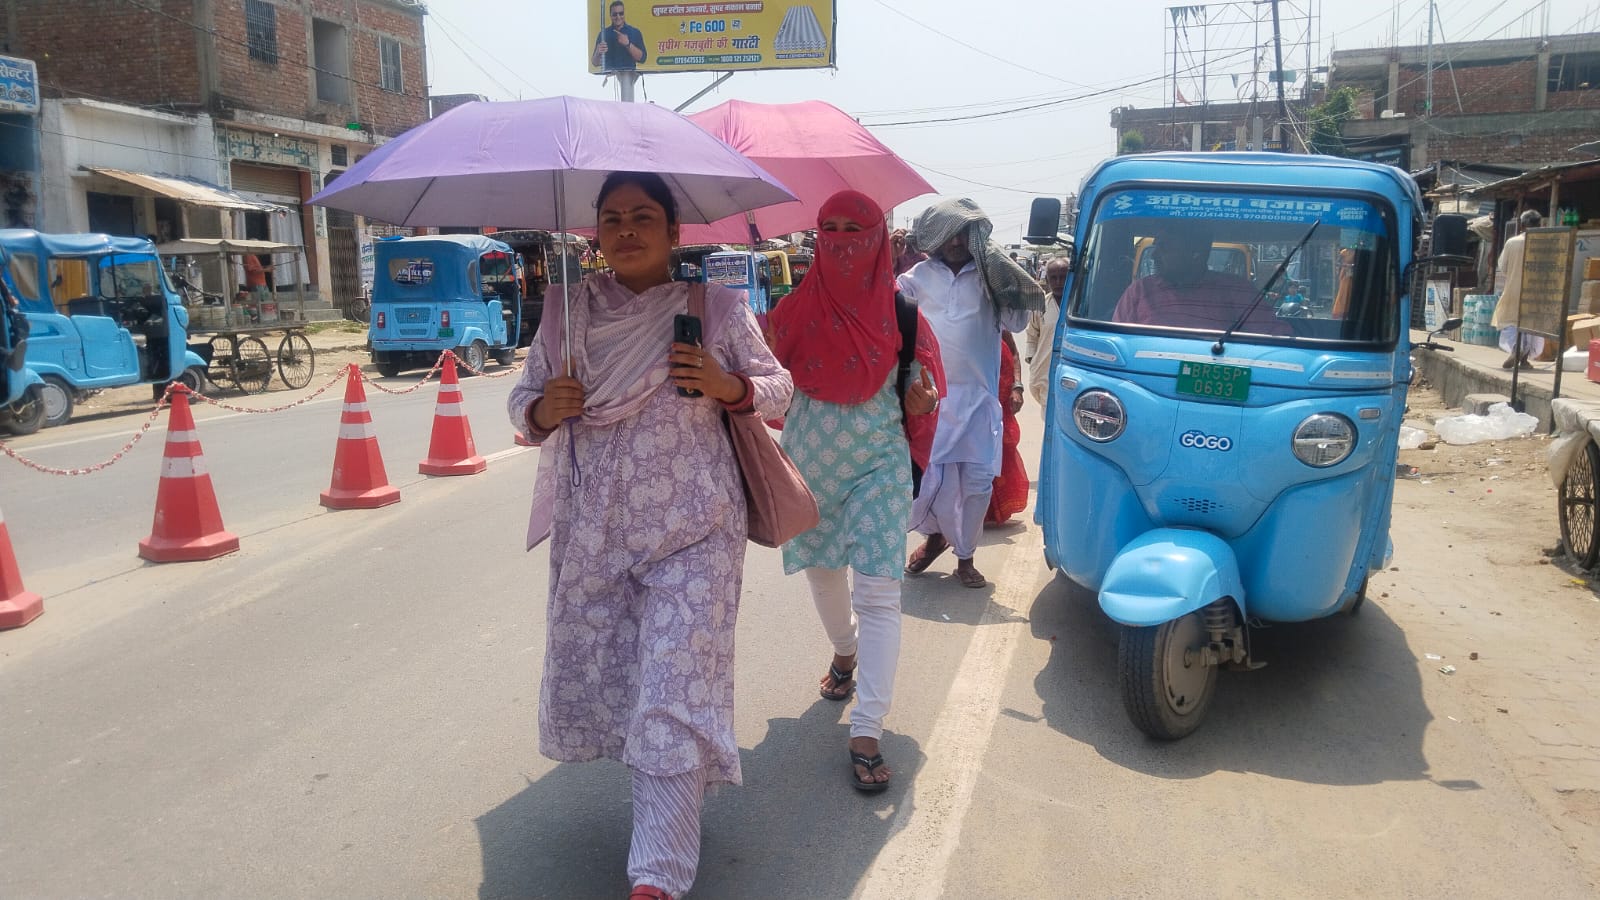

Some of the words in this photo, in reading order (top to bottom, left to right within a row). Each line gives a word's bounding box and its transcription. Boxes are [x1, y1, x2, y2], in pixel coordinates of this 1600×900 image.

[689, 21, 702, 33] Fe
[704, 20, 725, 32] 600
[717, 37, 728, 48] की
[732, 35, 760, 49] गारंटी
[1145, 193, 1242, 207] अभिनव
[1250, 200, 1334, 212] बजाज
[1192, 365, 1241, 381] BR55P
[1194, 380, 1233, 396] 0633
[1182, 434, 1230, 450] GOGO
